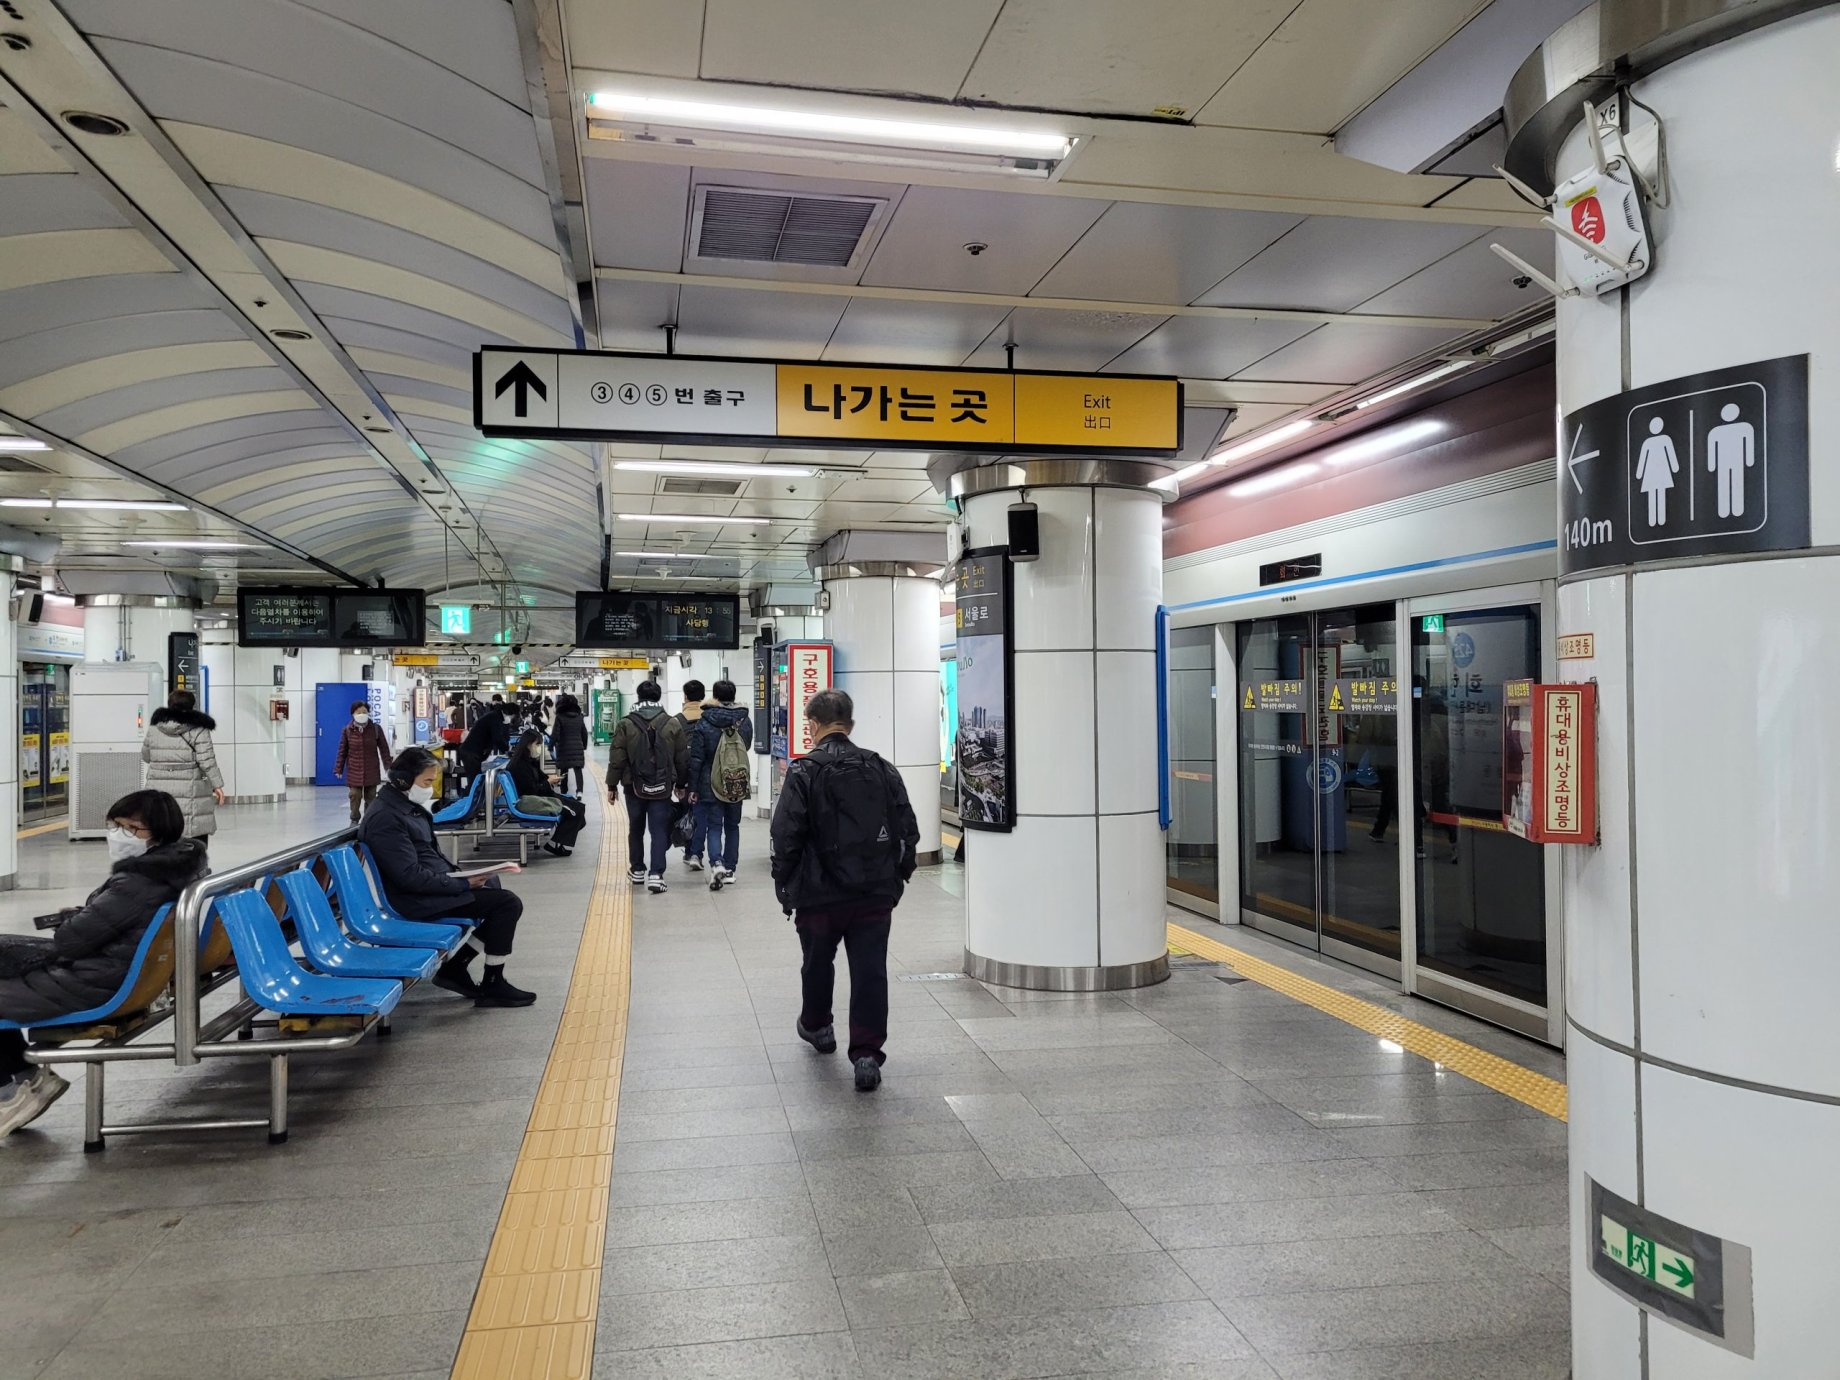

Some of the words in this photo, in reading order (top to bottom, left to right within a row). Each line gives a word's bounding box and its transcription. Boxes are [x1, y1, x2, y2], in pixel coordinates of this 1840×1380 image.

[703, 389, 745, 407] 출구
[803, 383, 936, 423] 나가는
[950, 389, 988, 424] 곳
[1083, 394, 1112, 409] Exit
[1084, 414, 1111, 430] 出口
[1564, 516, 1613, 552] 140m
[972, 565, 985, 576] Exit
[255, 598, 270, 606] 고객
[664, 605, 697, 615] 지금시각
[964, 606, 989, 621] 서울로
[259, 617, 282, 626] 주시기
[285, 617, 317, 626] 바랍니다
[685, 618, 709, 628] 사당행
[1350, 680, 1376, 696] 발빠짐
[1554, 695, 1572, 828] 휴대용비상조명등
